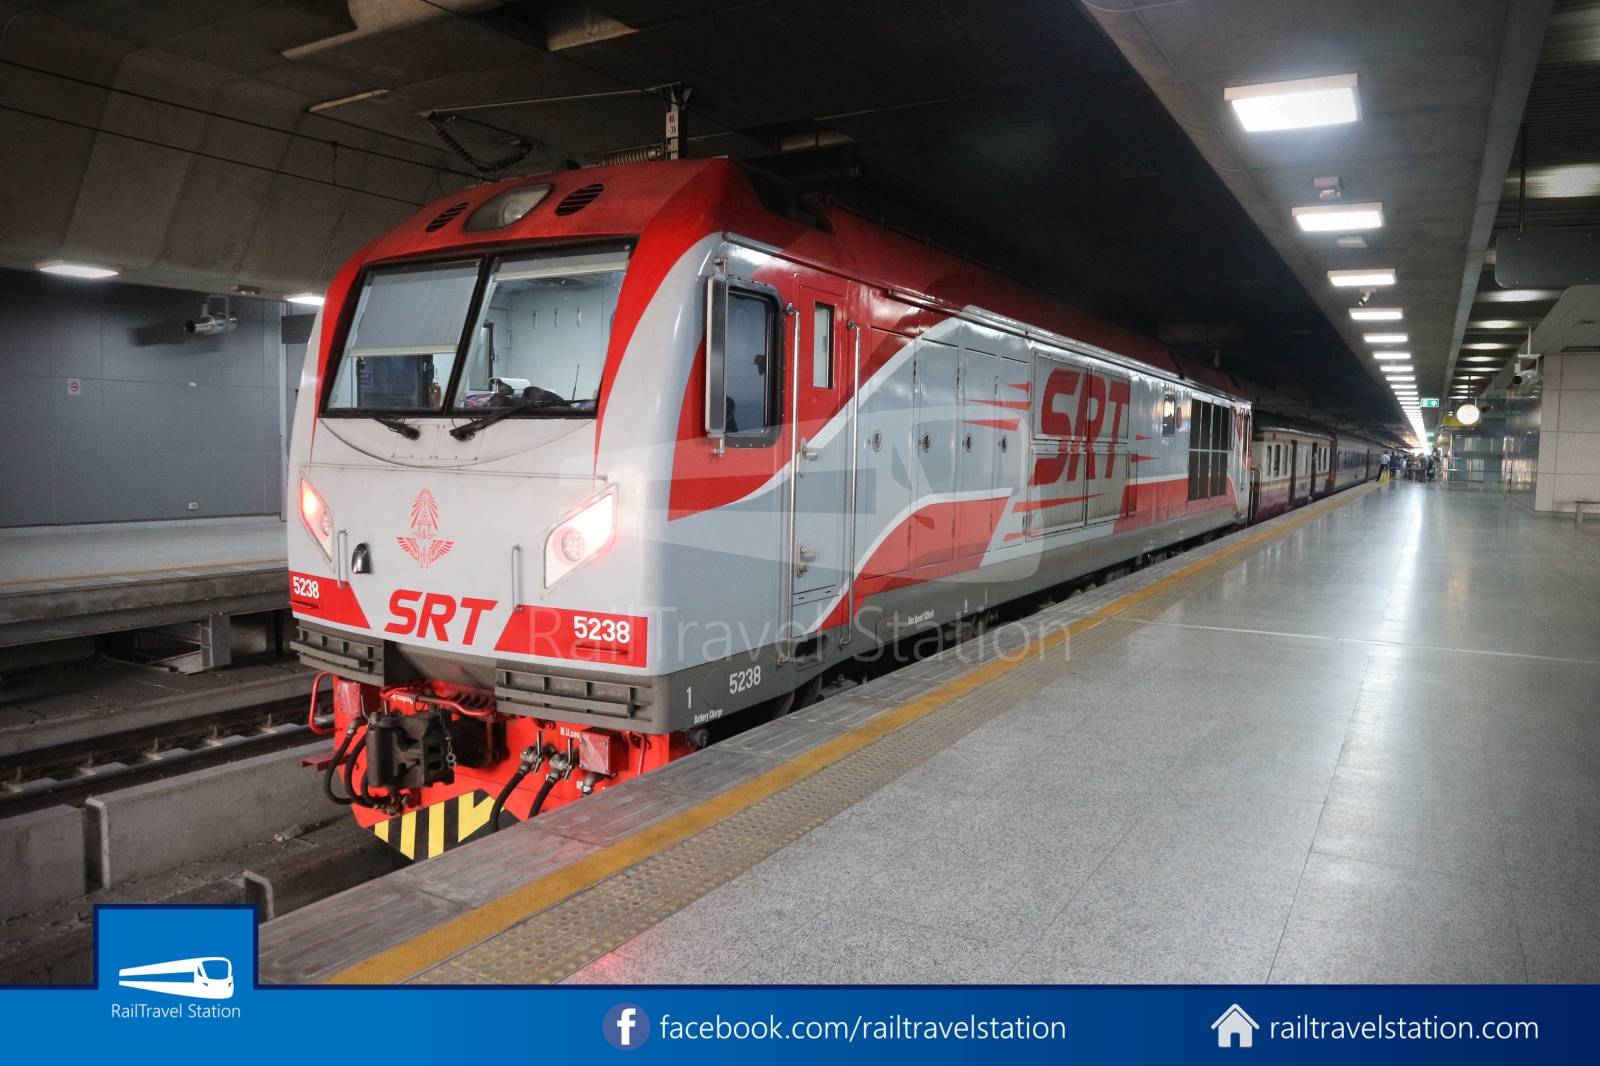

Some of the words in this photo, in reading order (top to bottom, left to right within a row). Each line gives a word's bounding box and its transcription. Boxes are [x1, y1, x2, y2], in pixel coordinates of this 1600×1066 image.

[1027, 367, 1131, 486] SRT
[293, 576, 320, 599] 5238
[384, 588, 498, 646] SRT
[573, 615, 630, 644] 5238
[729, 665, 761, 695] 5238
[686, 686, 692, 709] 1
[694, 713, 709, 725] Battery
[709, 708, 723, 719] Charge
